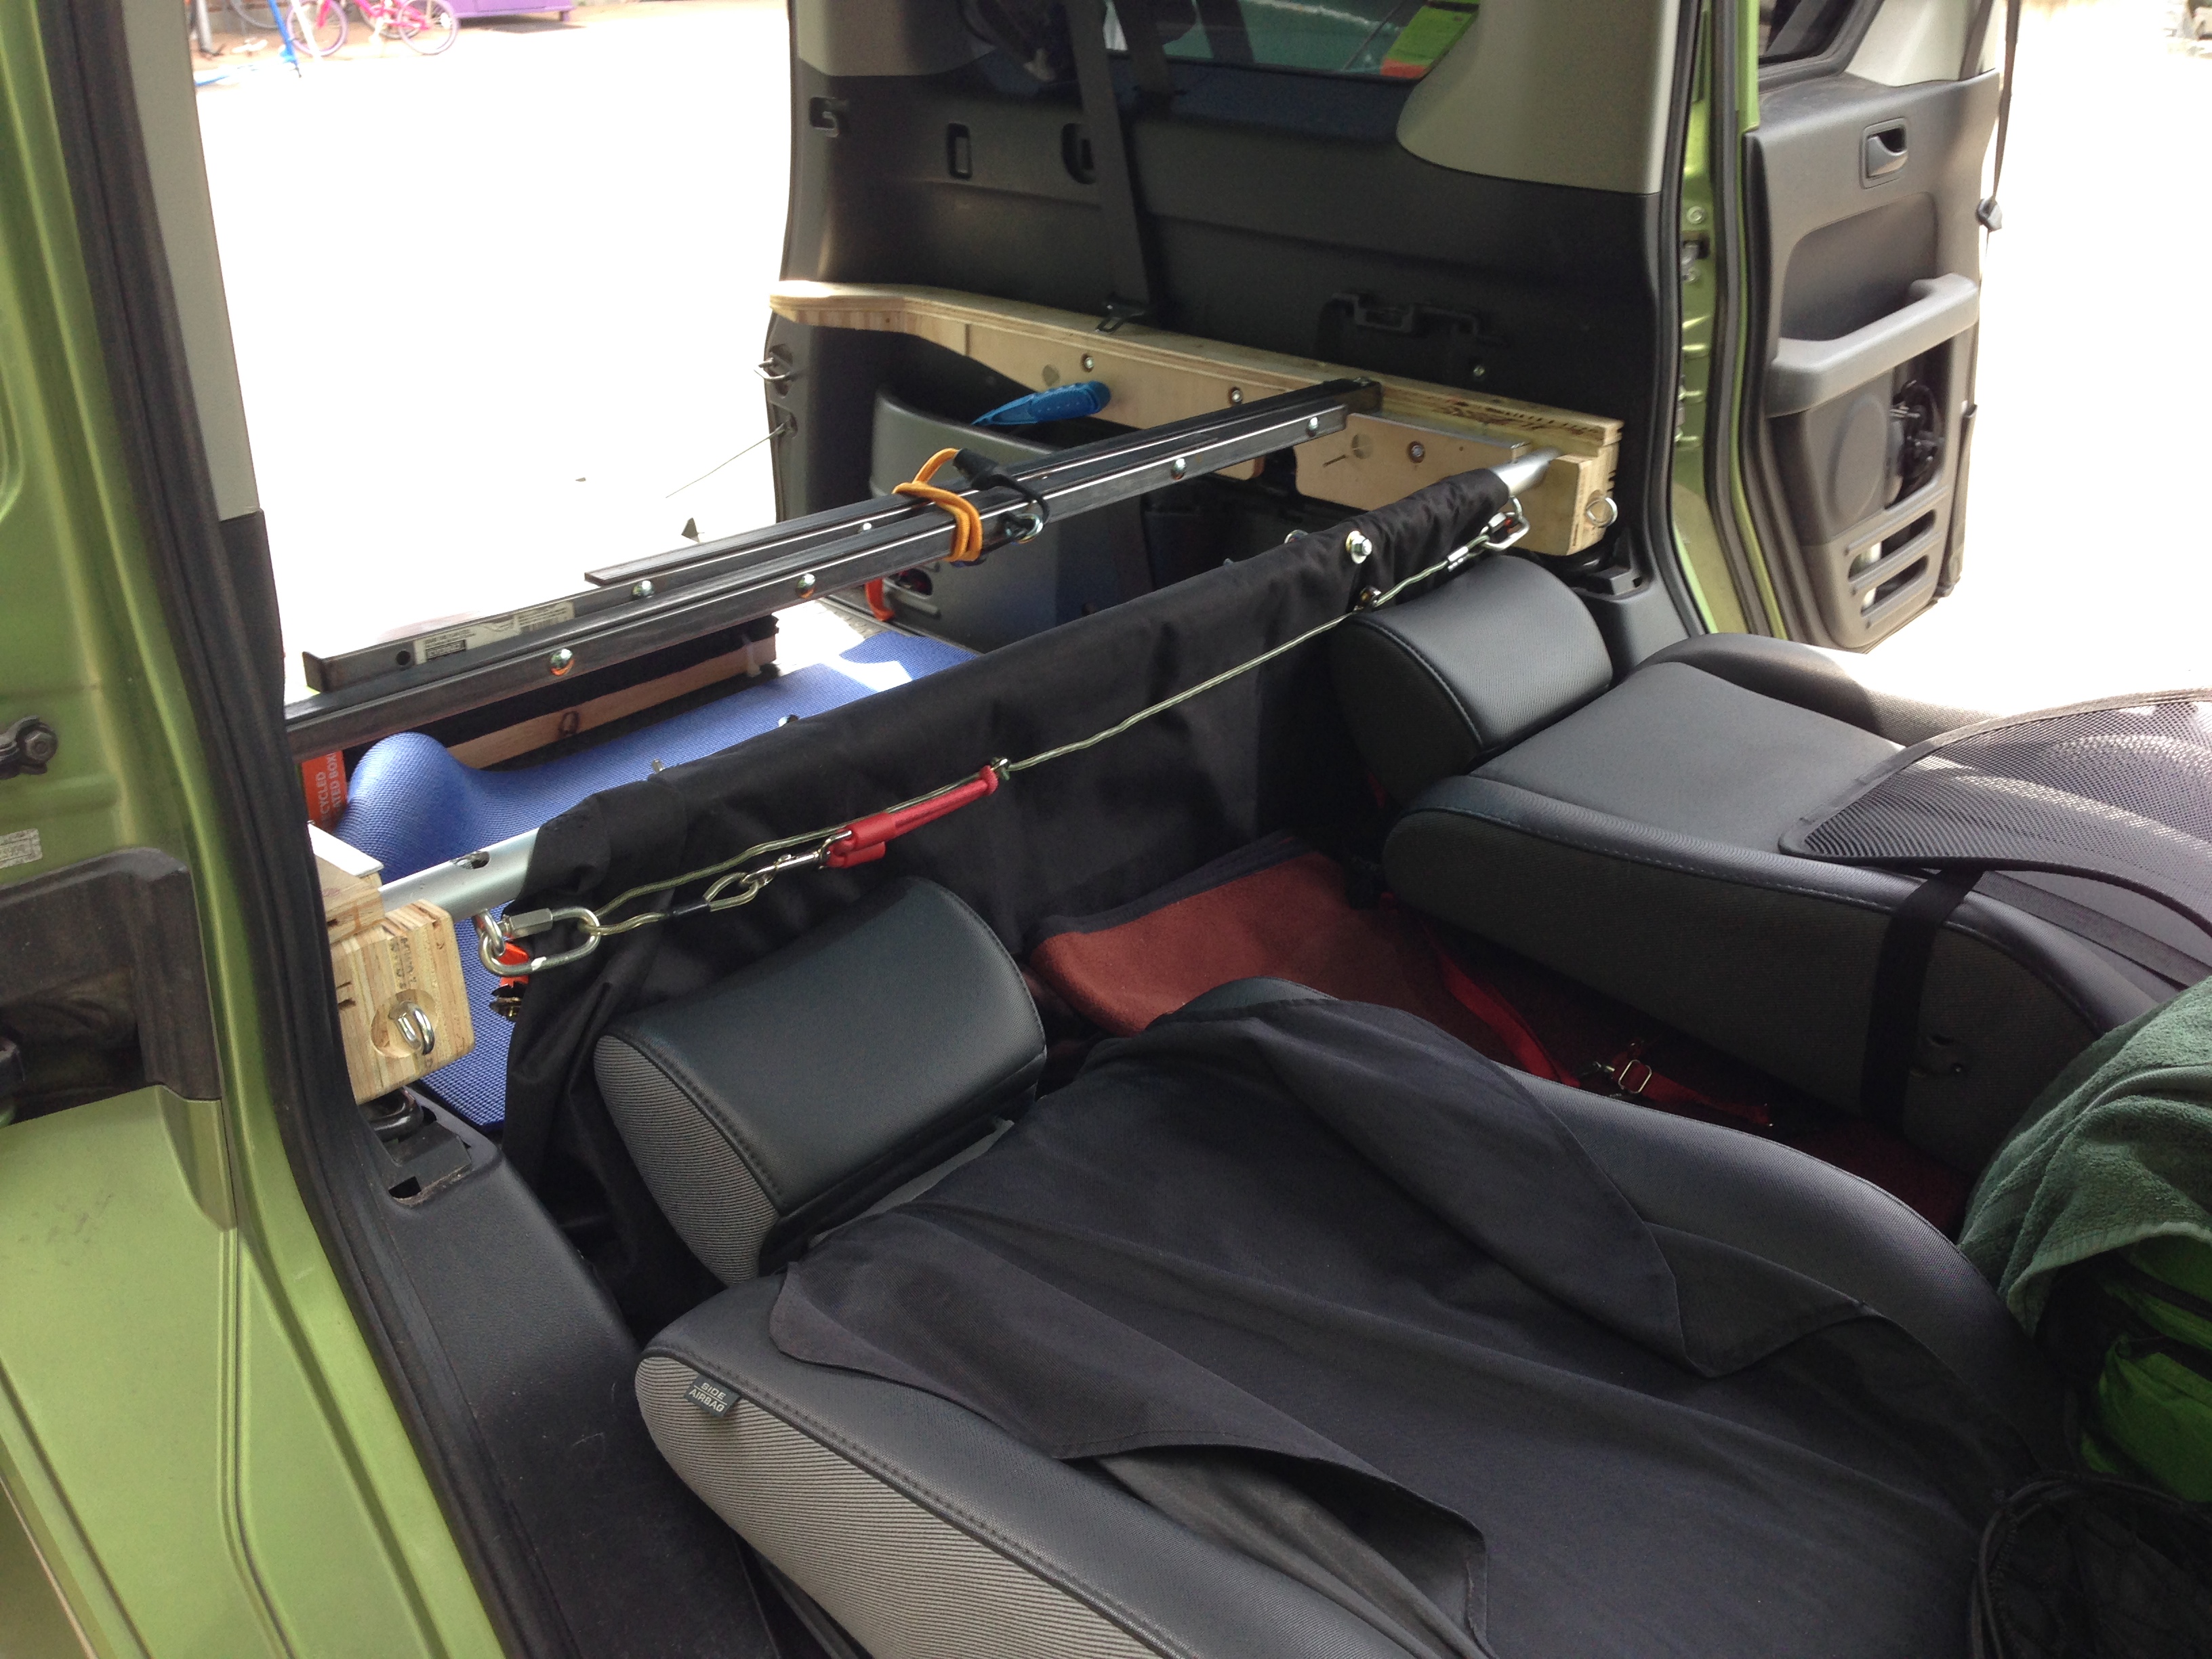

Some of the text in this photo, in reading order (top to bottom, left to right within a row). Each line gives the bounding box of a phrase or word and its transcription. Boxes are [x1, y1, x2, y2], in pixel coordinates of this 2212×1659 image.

[326, 752, 339, 779] BOX
[689, 1389, 725, 1412] AIRBAG
[700, 1382, 726, 1400] SIDE
